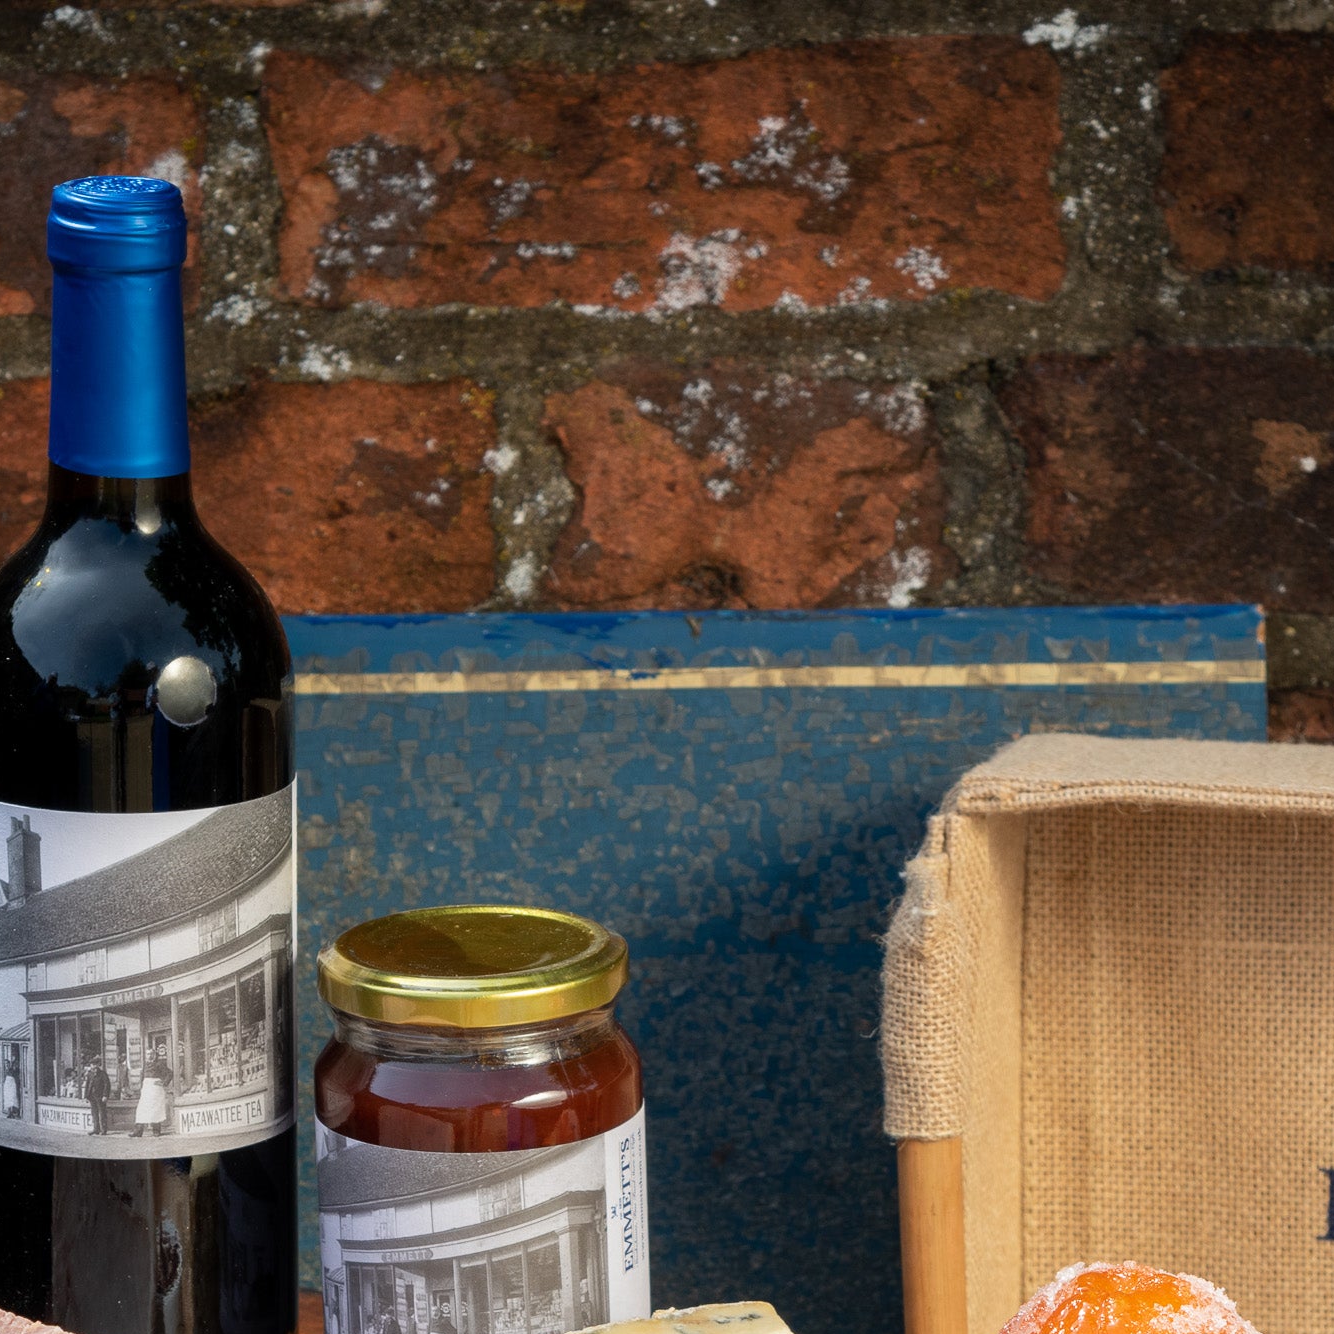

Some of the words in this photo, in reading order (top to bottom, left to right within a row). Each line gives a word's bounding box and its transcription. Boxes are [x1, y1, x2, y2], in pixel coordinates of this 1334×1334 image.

[82, 1112, 93, 1130] TE
[181, 1104, 242, 1132] MAZAWATTEE
[246, 1098, 262, 1124] TEA
[620, 1137, 634, 1272] EMMETT'S
